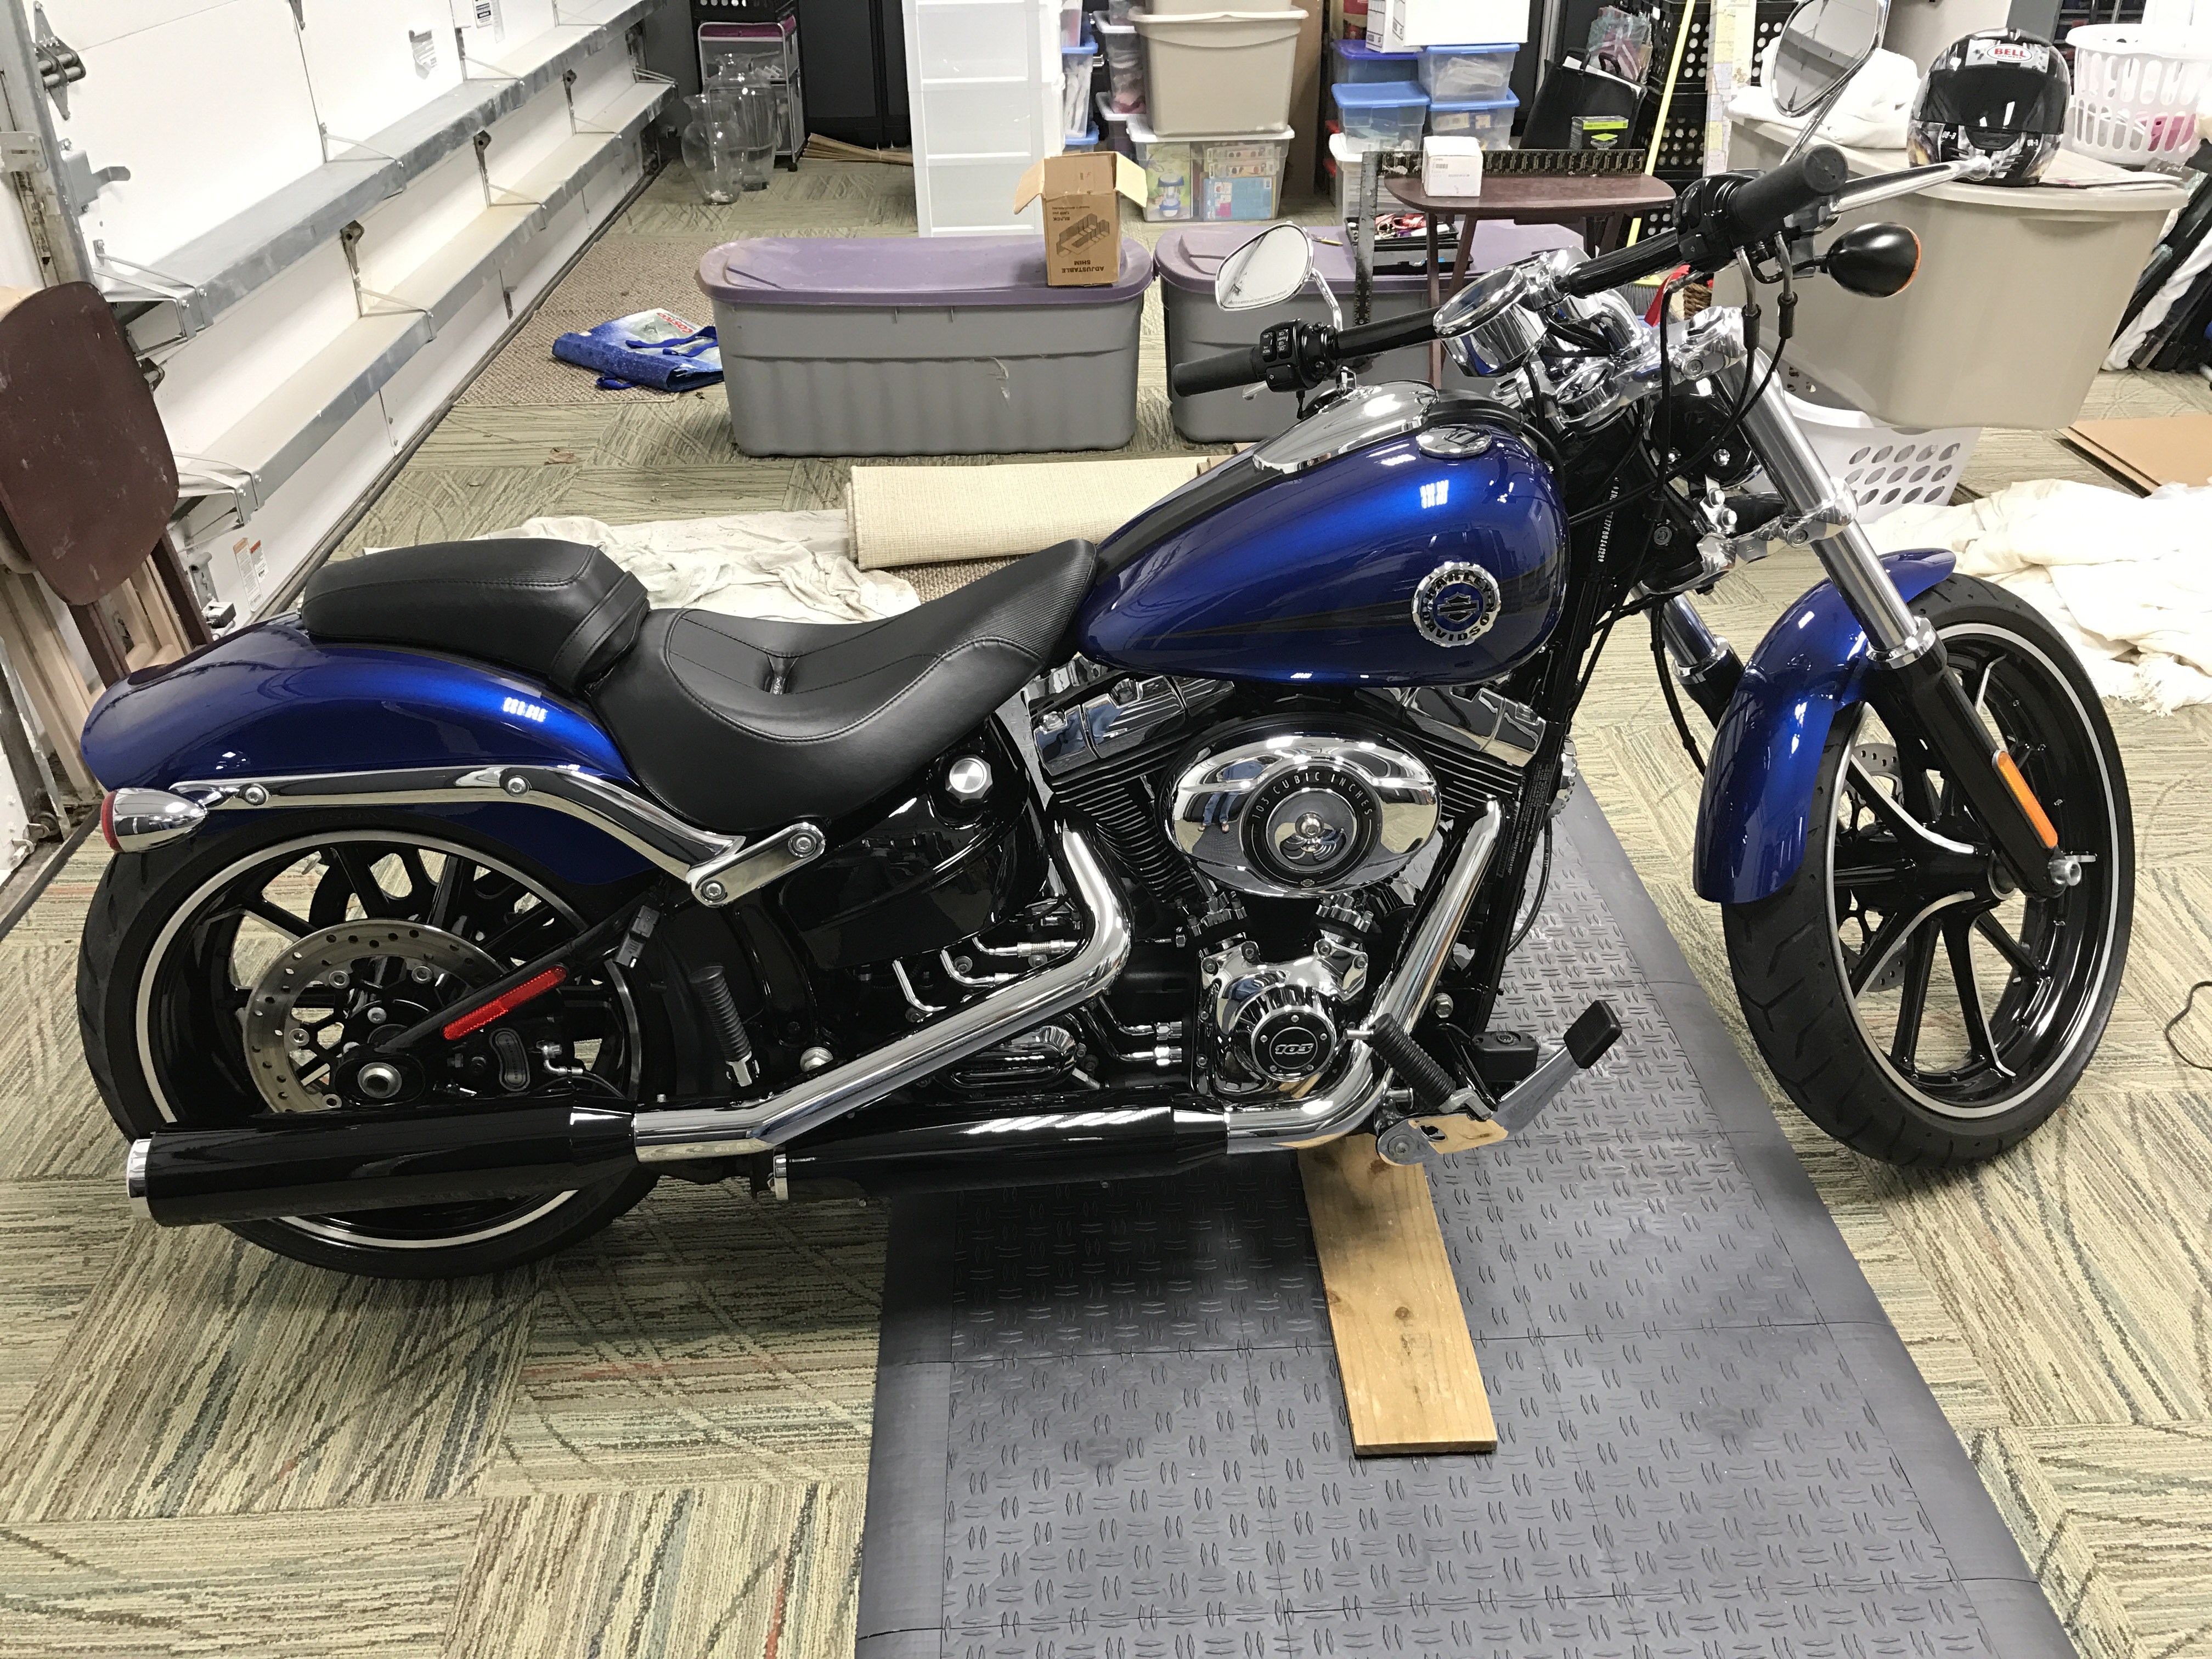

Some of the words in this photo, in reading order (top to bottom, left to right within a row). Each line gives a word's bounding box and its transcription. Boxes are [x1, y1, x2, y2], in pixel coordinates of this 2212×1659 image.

[1994, 48, 2027, 58] BELL
[656, 312, 693, 334] COSTCO
[1252, 797, 1269, 819] 103
[1273, 772, 1320, 794] CUBIC
[1331, 774, 1373, 815] INCHES
[1274, 1043, 1314, 1055] 103
